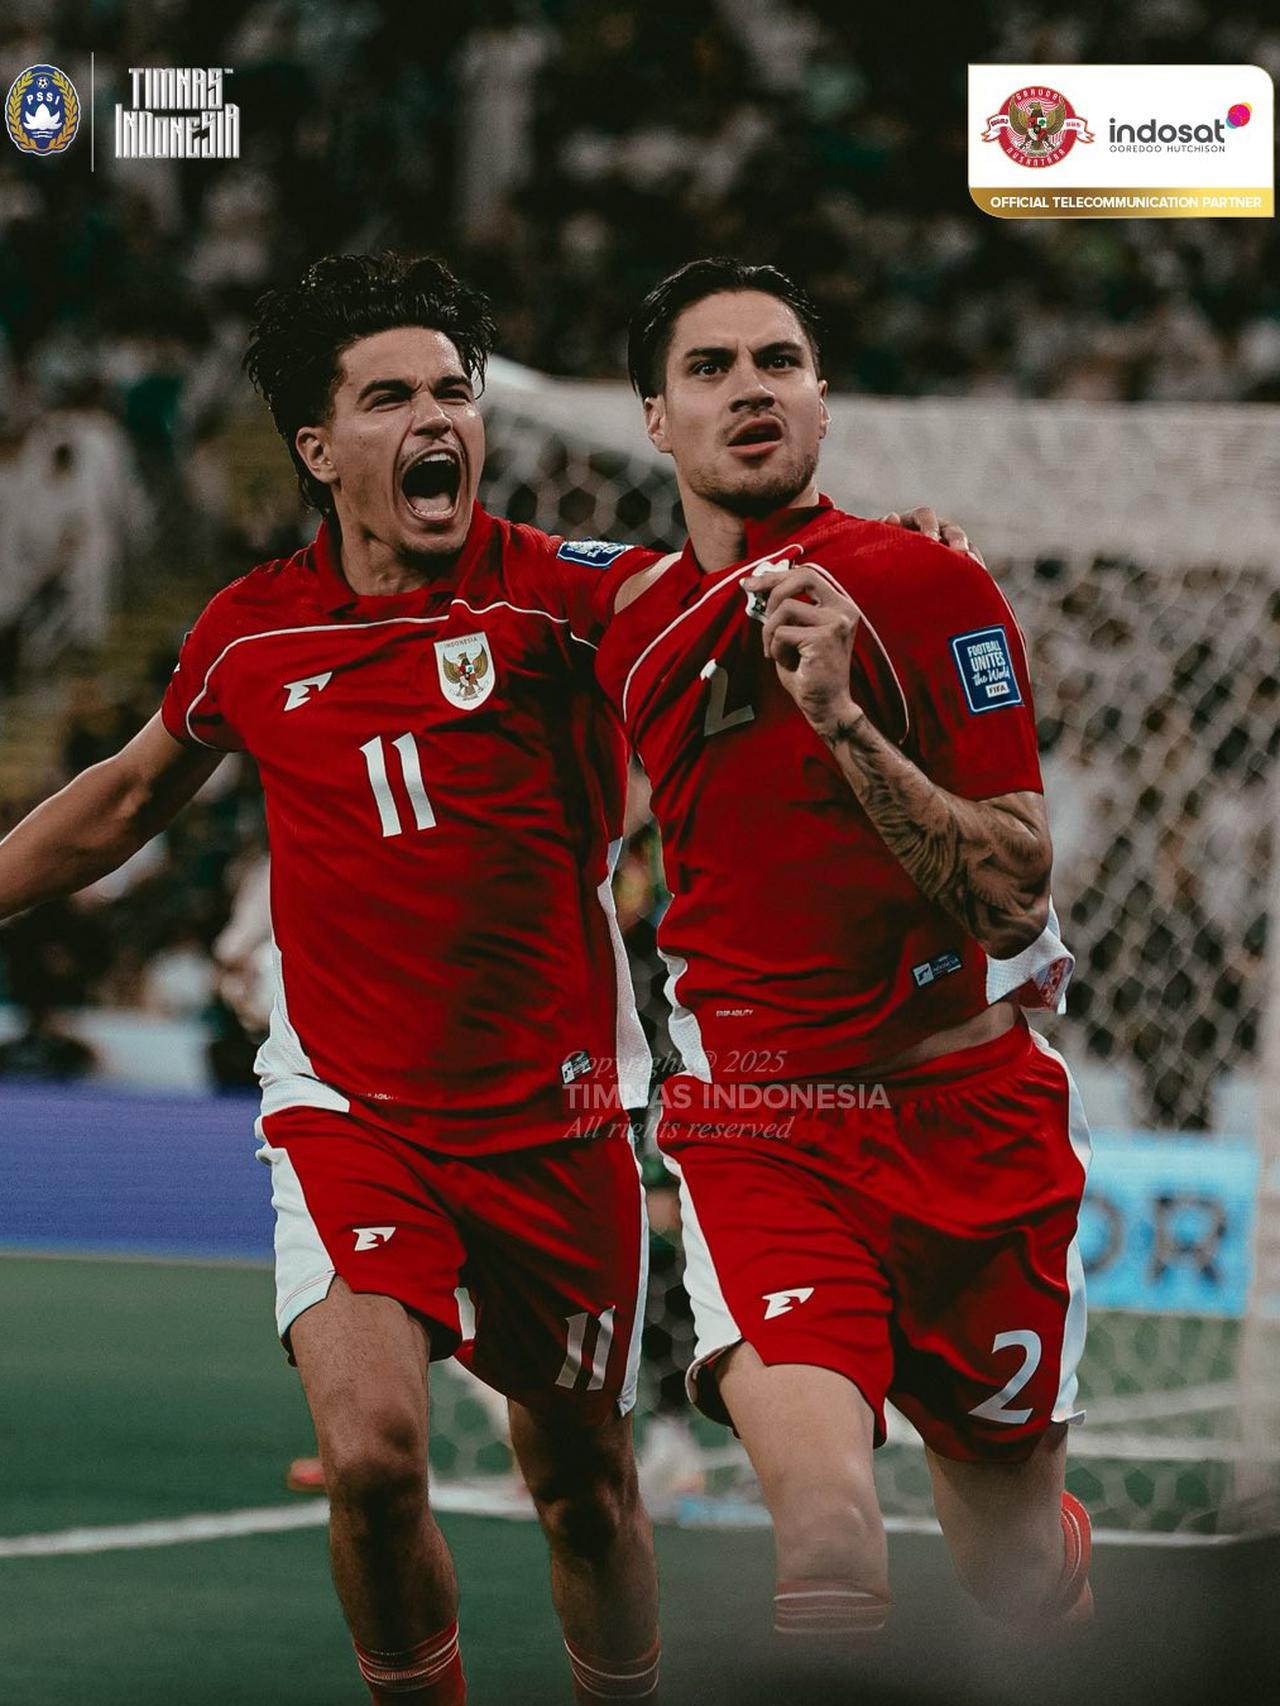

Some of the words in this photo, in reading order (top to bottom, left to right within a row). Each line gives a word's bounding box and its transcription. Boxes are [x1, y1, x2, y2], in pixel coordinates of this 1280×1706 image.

[967, 640, 1002, 657] FOOTBALL
[971, 652, 1006, 672] UNITES
[989, 685, 1006, 695] FIFA
[359, 732, 437, 837] 11
[555, 1305, 616, 1391] 11
[968, 1329, 1042, 1424] 2
